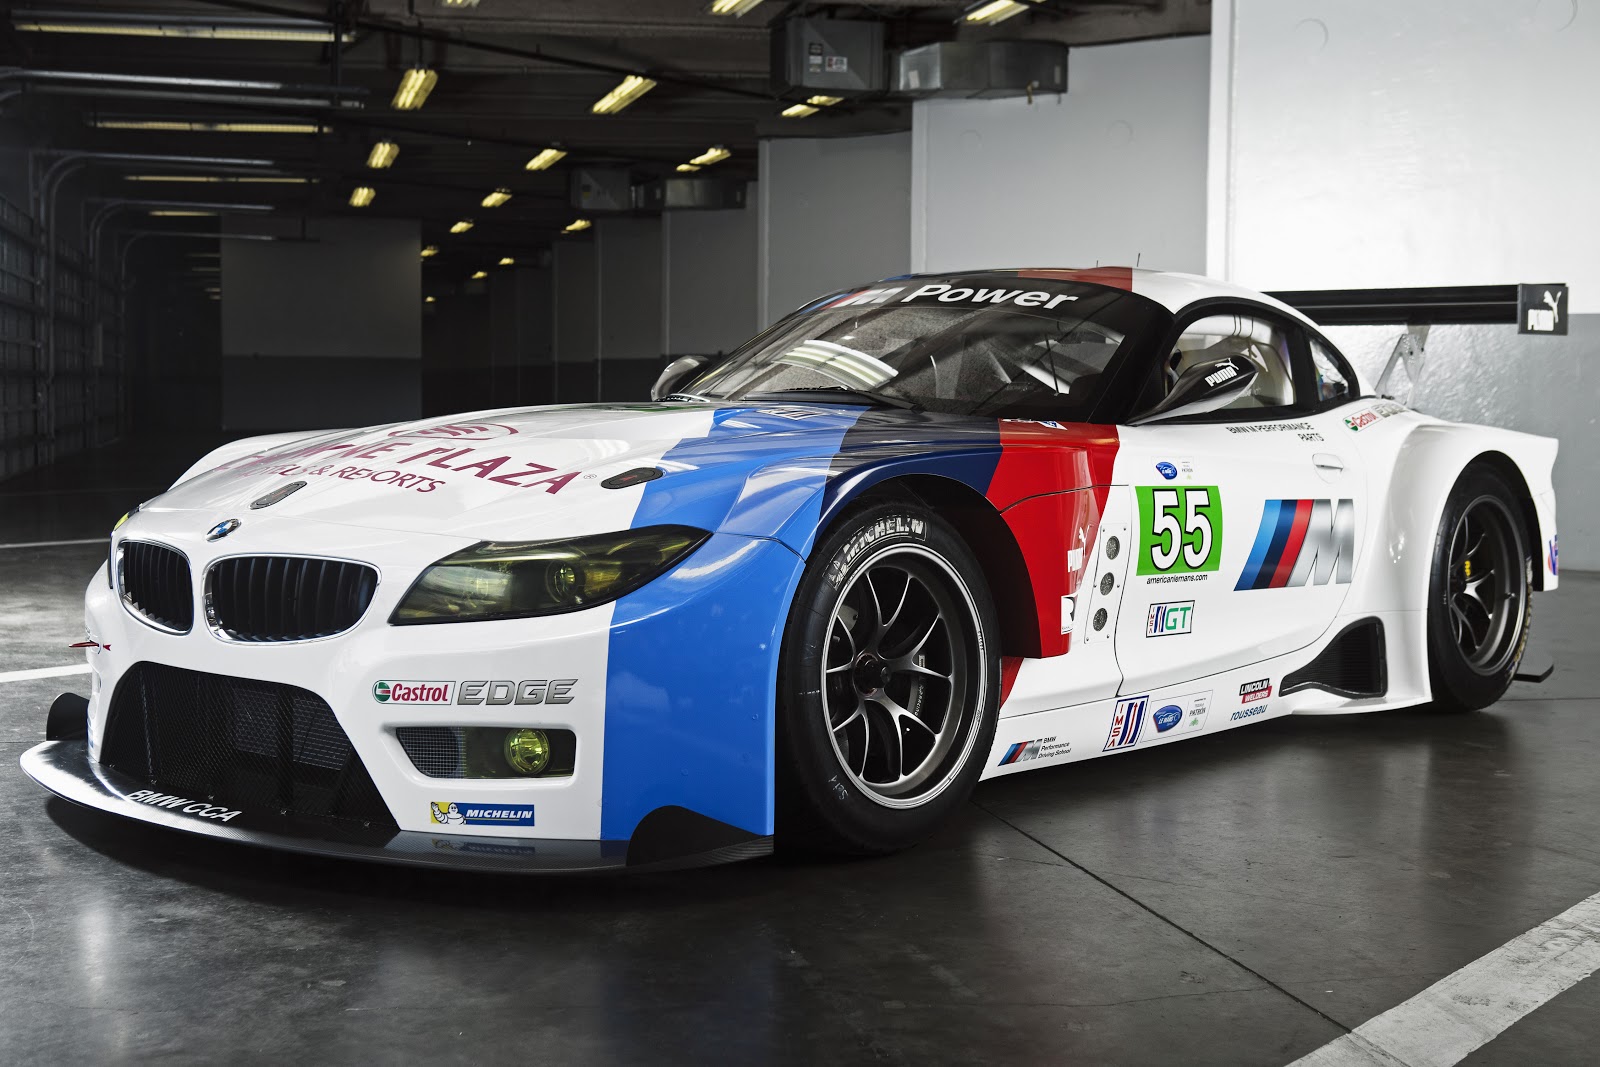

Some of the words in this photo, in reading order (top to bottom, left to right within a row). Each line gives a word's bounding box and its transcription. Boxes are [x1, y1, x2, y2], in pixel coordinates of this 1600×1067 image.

[901, 284, 1078, 310] Power
[1205, 367, 1237, 387] PUMA
[843, 516, 924, 562] MICHELIN
[1150, 488, 1214, 572] 55
[1147, 574, 1208, 585] americanlemans.com
[1165, 606, 1191, 631] GT
[391, 683, 448, 702] Castrol
[457, 679, 578, 705] EDGE
[1241, 680, 1268, 694] LINCOLN
[1230, 704, 1268, 721] rousseau
[1041, 742, 1070, 751] Performance
[125, 789, 196, 809] BMW
[183, 801, 242, 822] CCA
[466, 809, 533, 819] MICHELIN
